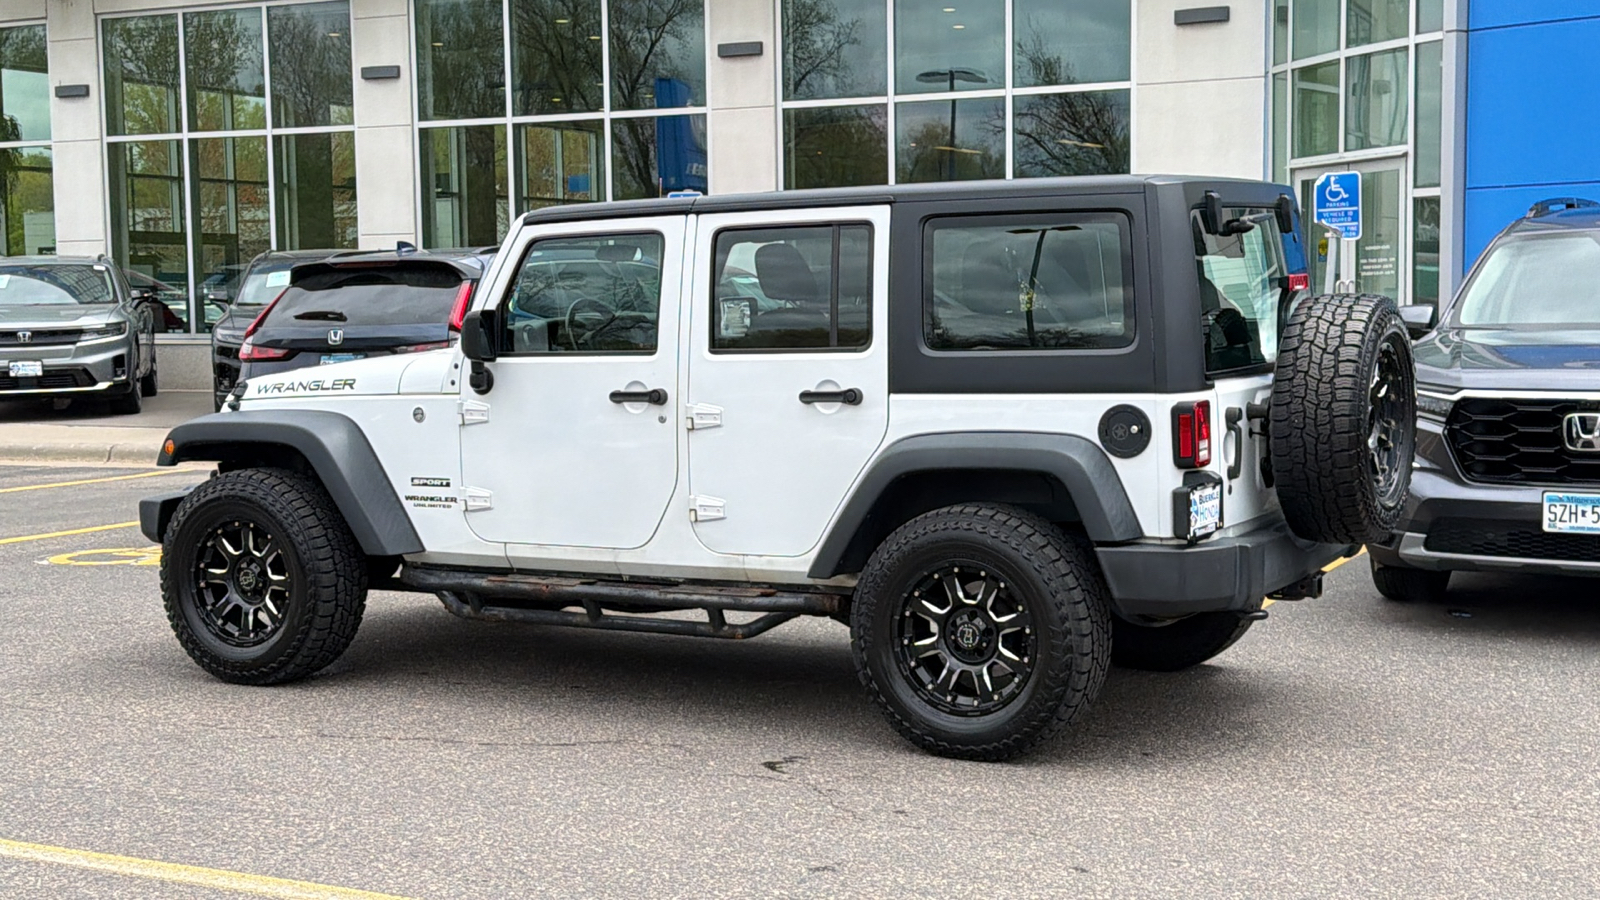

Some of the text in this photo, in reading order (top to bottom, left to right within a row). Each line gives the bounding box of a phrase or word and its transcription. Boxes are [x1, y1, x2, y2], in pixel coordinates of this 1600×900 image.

[258, 379, 356, 394] WRANGLER
[405, 495, 457, 503] WRANGLER
[1200, 504, 1219, 521] HONDA
[1548, 504, 1578, 523] SZH
